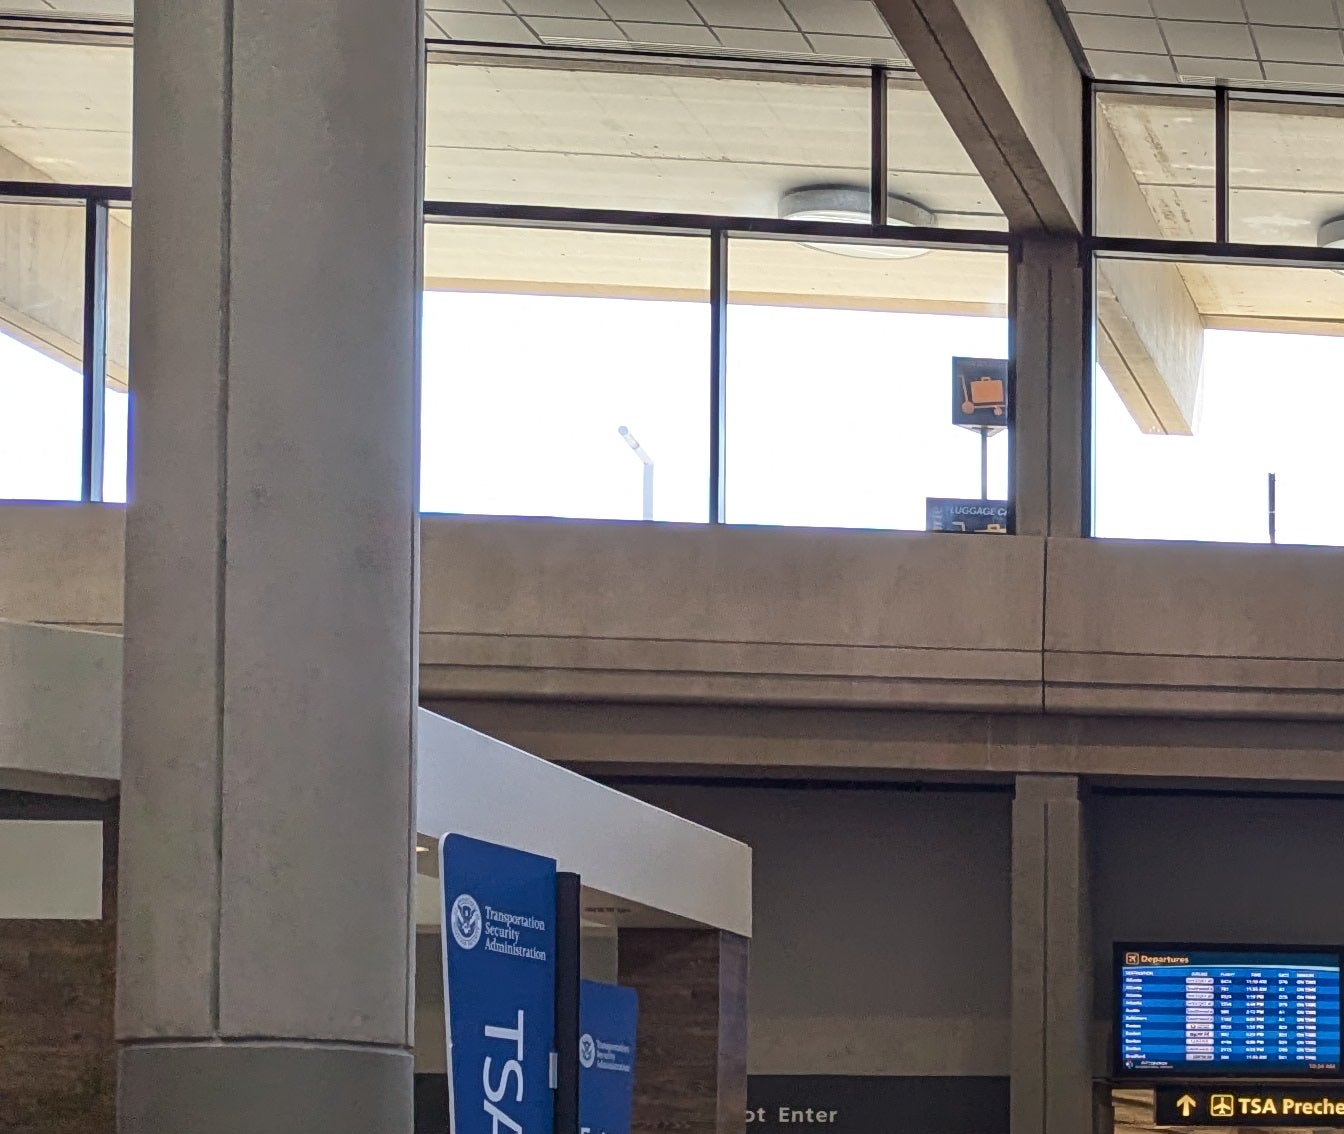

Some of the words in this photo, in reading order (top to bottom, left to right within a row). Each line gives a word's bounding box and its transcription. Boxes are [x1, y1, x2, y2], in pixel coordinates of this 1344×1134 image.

[485, 905, 545, 931] Transportation
[485, 922, 520, 945] Security
[484, 939, 546, 961] Administration
[1141, 955, 1190, 965] Departures
[746, 1107, 766, 1122] ot
[778, 1106, 838, 1122] Enter
[1238, 1097, 1277, 1115] TSA
